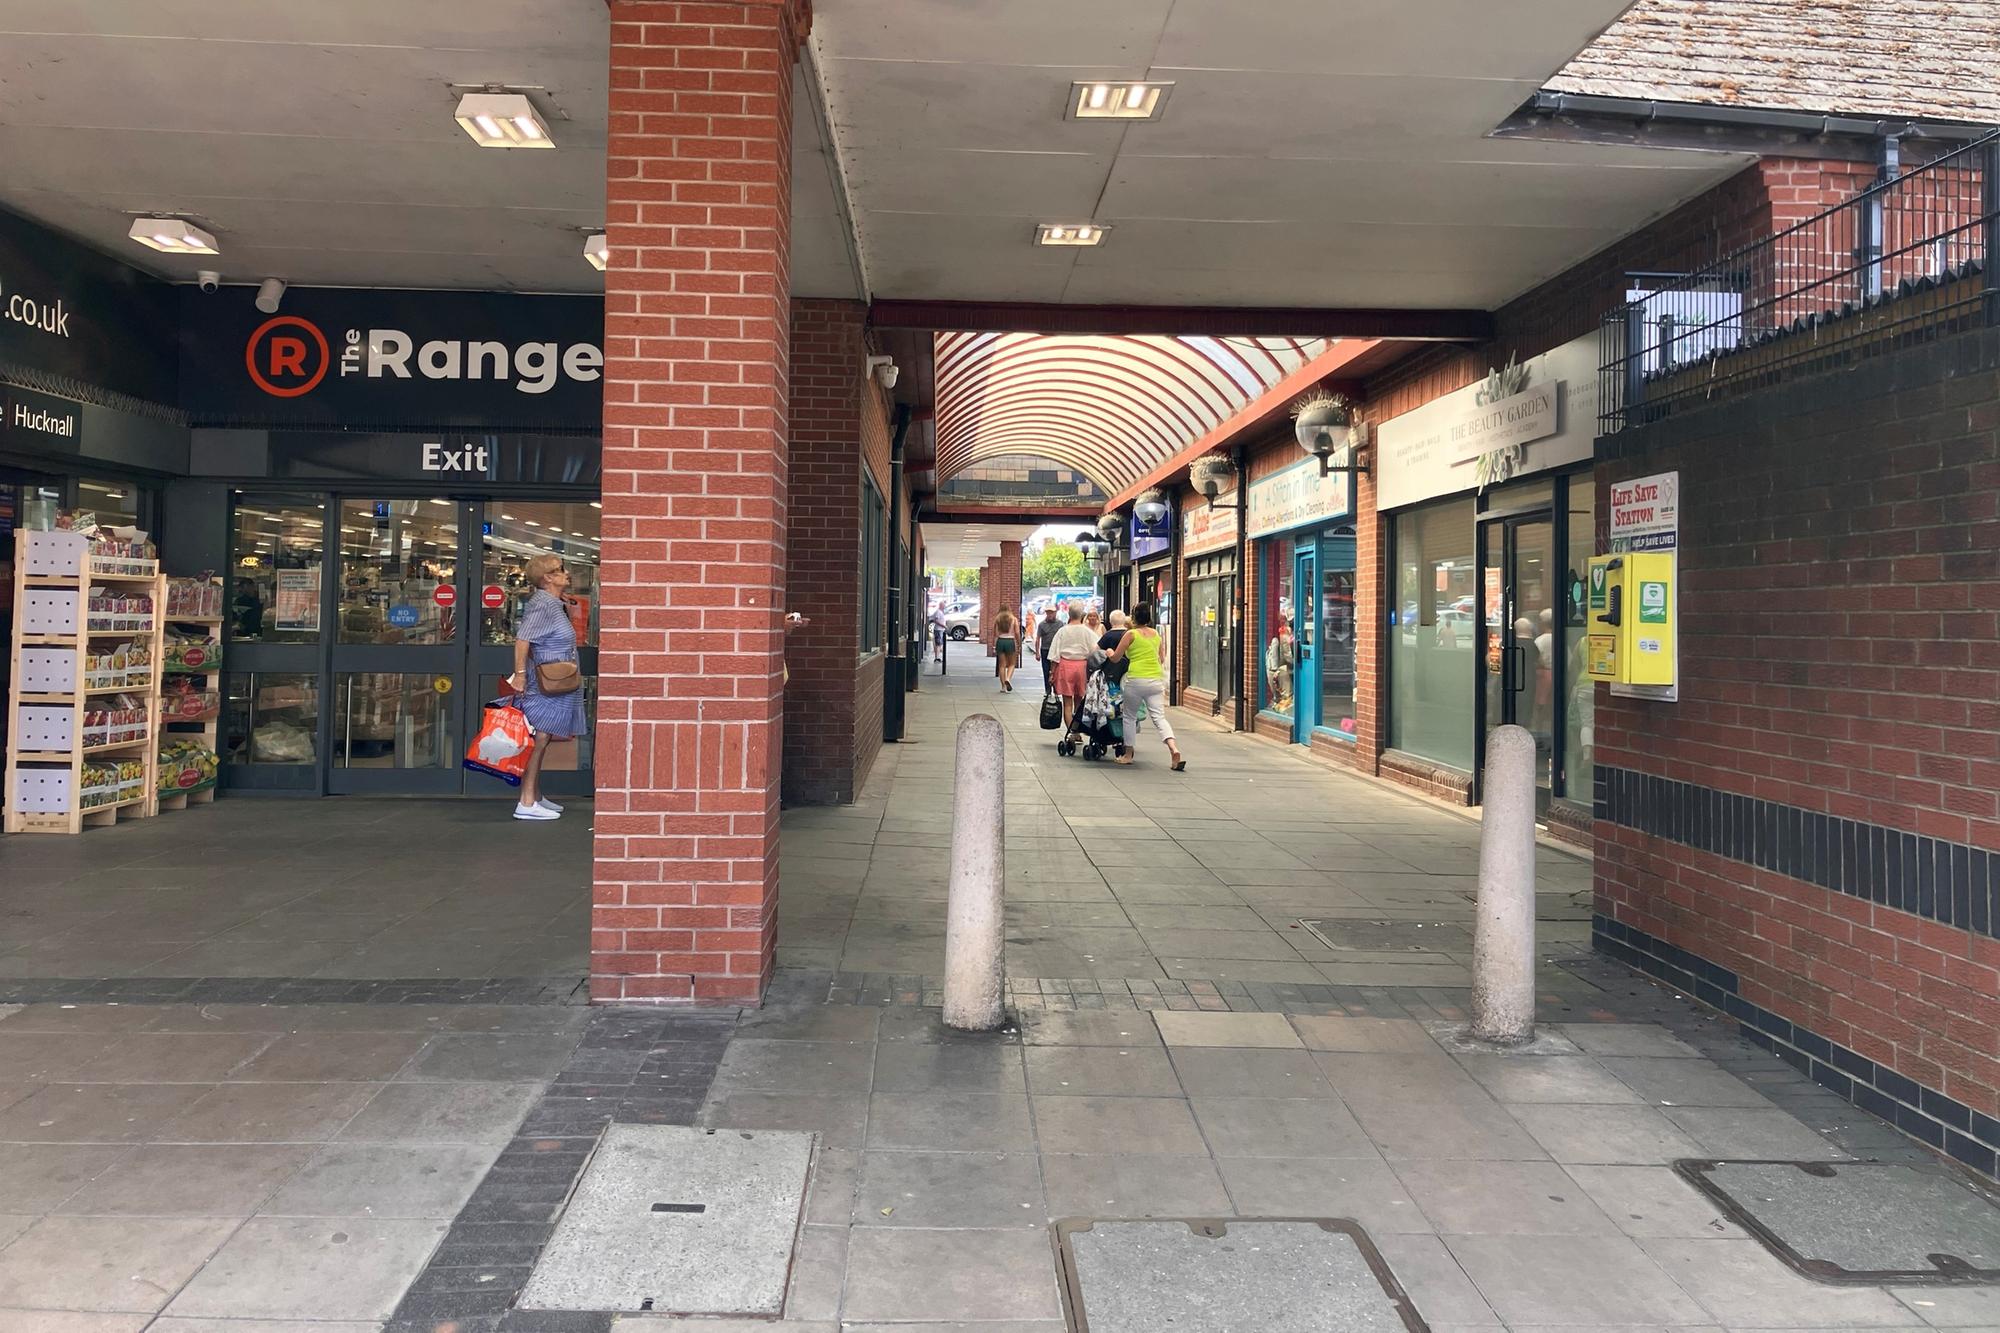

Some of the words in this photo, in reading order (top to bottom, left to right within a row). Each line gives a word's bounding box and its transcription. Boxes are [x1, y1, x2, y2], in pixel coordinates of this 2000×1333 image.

[270, 337, 306, 377] R
[340, 328, 361, 376] The
[368, 329, 604, 394] Range
[15, 404, 73, 437] Hucknall
[1451, 424, 1466, 442] THE
[1468, 409, 1505, 437] BEAUTY
[1507, 395, 1549, 423] GARDEN
[422, 443, 488, 473] Exit
[1615, 507, 1654, 527] STATION
[1646, 536, 1659, 547] SAVE
[1659, 535, 1675, 545] LIVES
[391, 615, 415, 623] ENTRY
